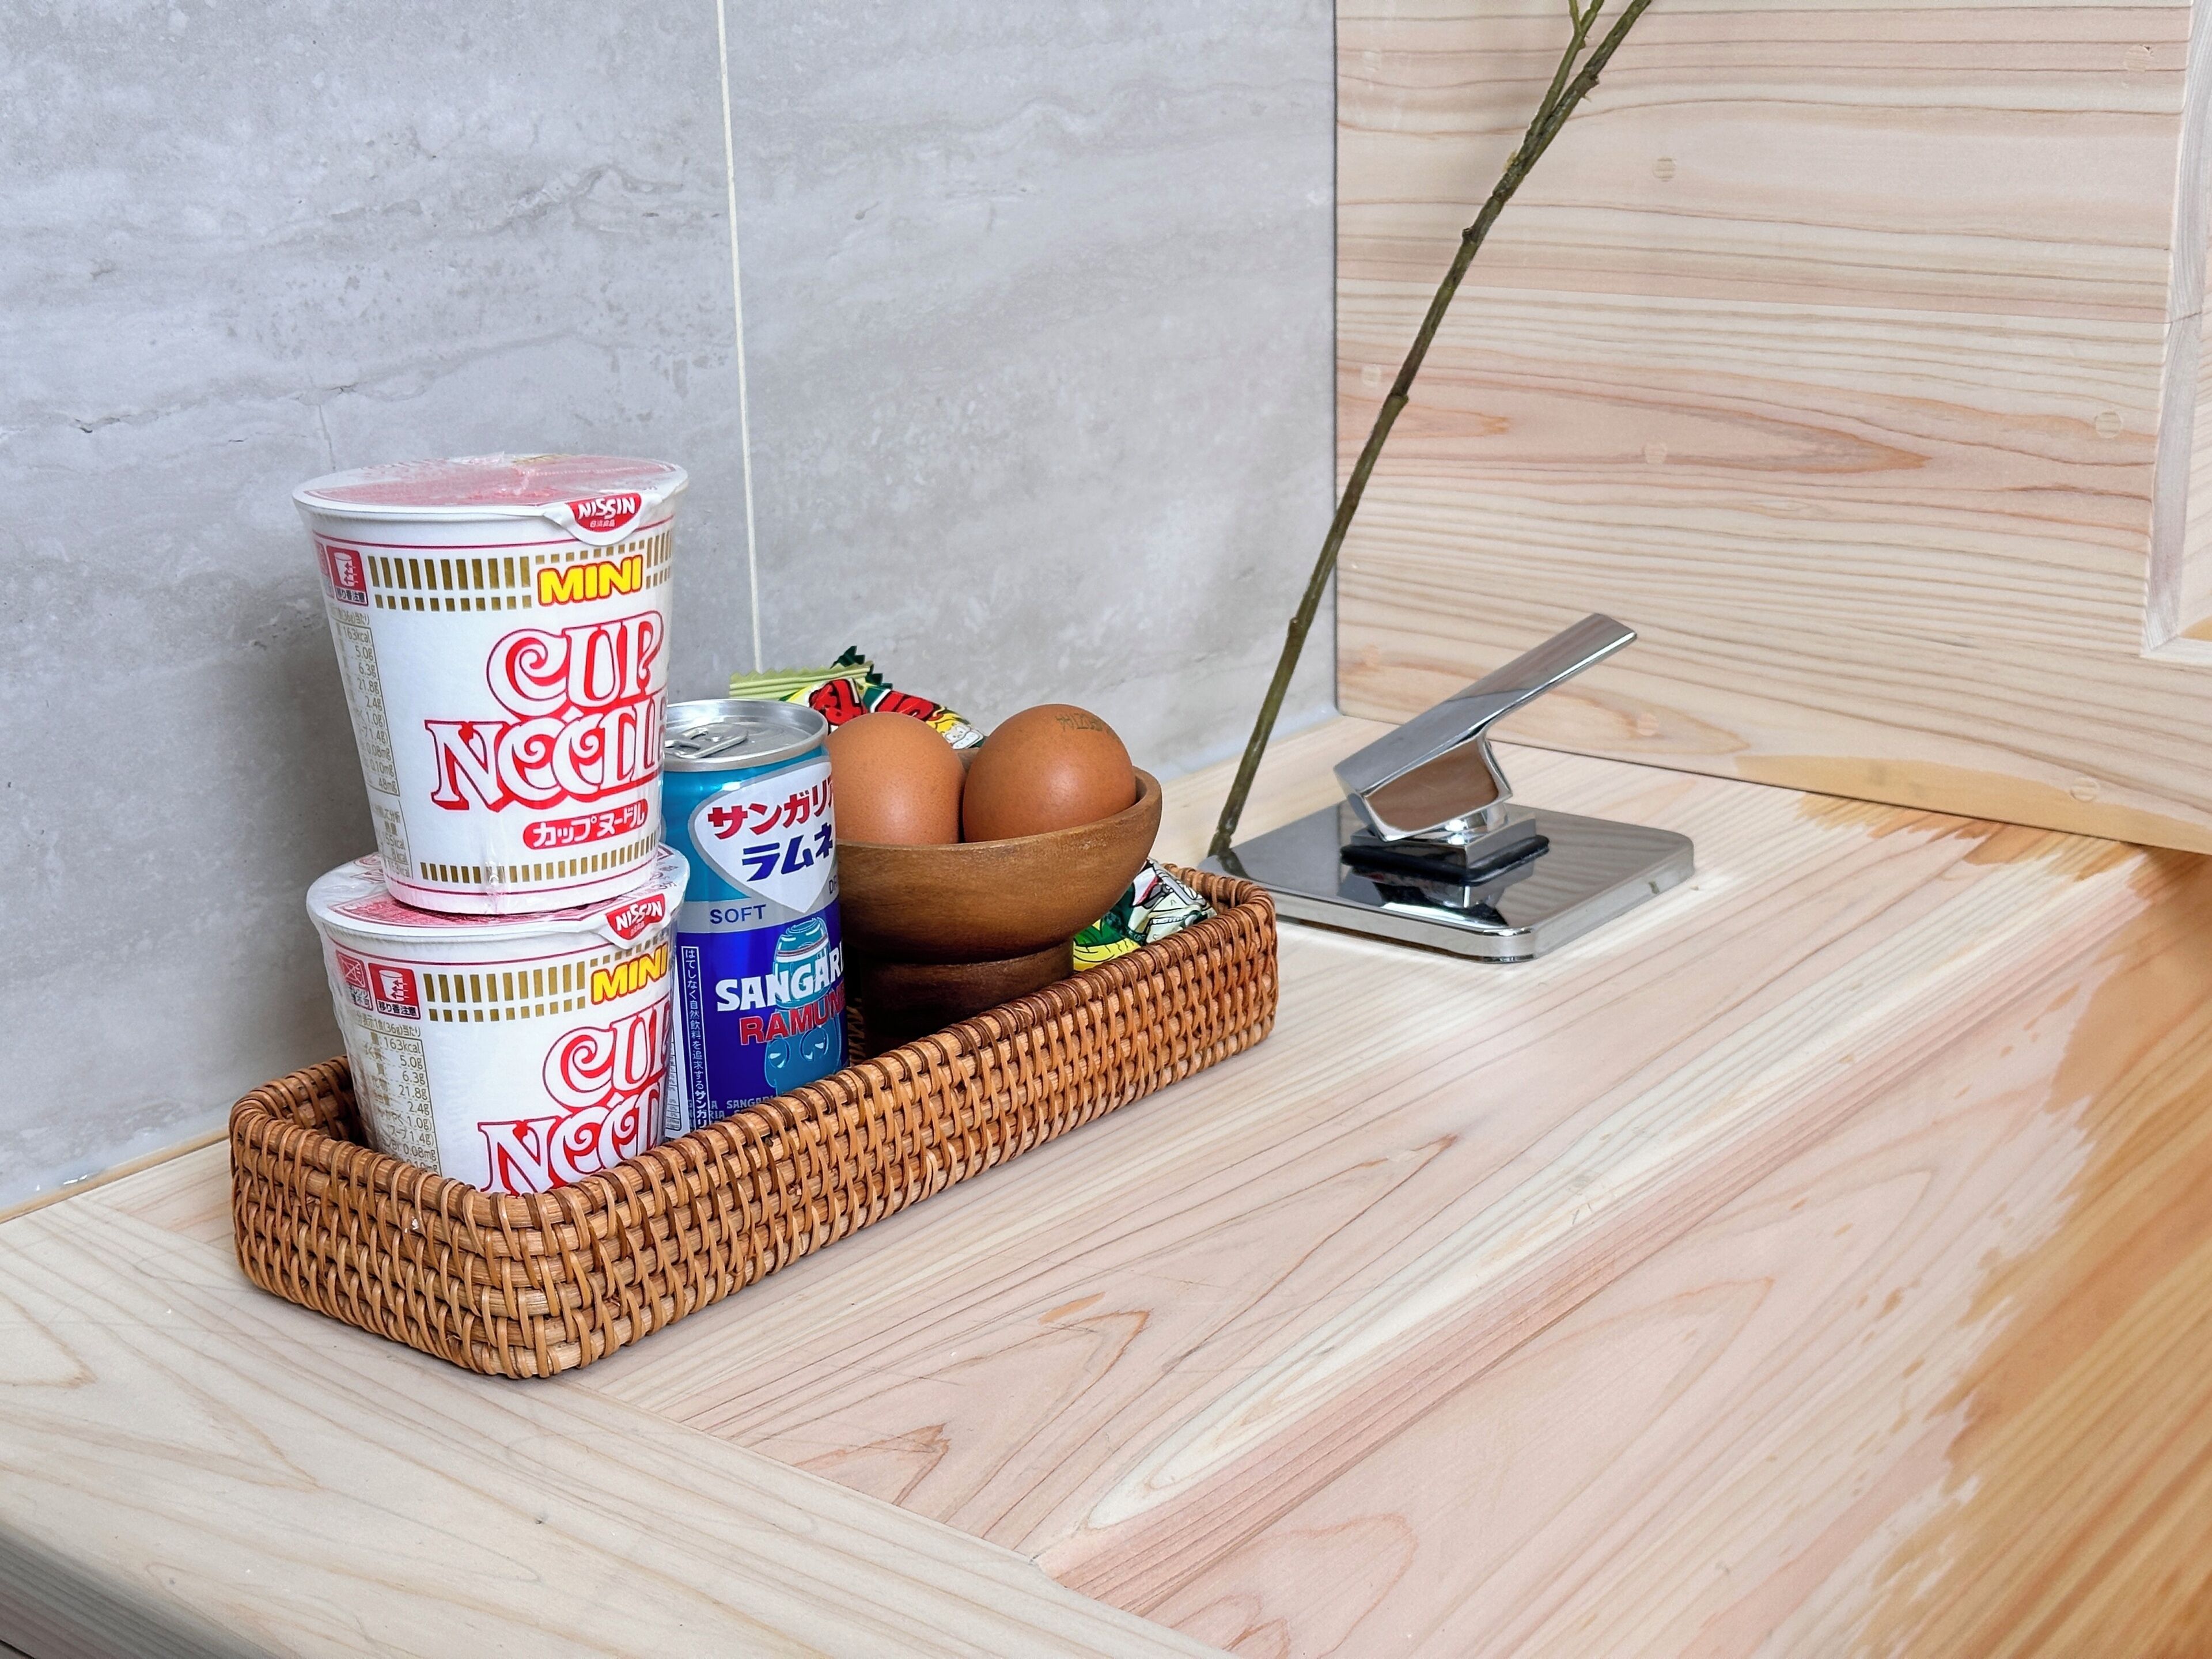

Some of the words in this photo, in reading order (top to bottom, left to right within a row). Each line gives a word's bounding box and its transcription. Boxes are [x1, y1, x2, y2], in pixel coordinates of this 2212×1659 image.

[578, 497, 635, 520] NISSIN
[537, 555, 643, 607] MINI
[355, 645, 374, 661] 5.0g
[359, 662, 376, 677] 6.3g
[487, 611, 664, 717] CUP
[357, 677, 380, 695] 21.8g
[365, 695, 382, 711] 2.4g
[532, 804, 644, 848] カップヌードル
[742, 822, 833, 882] ラムネ
[616, 900, 662, 931] NISSIN
[710, 904, 766, 924] SOFT
[591, 943, 668, 1005] MINI
[378, 1001, 417, 1016] 移り香注意
[384, 1037, 421, 1054] 163kcal
[400, 1055, 423, 1070] 5.0g
[402, 1071, 425, 1085] 6.3g
[399, 1085, 428, 1100] 21.8g
[407, 1101, 430, 1116] 2.4g
[407, 1116, 433, 1131] 1.0g)
[410, 1131, 434, 1146] 1.4g)
[404, 1143, 437, 1161] 0.08mg
